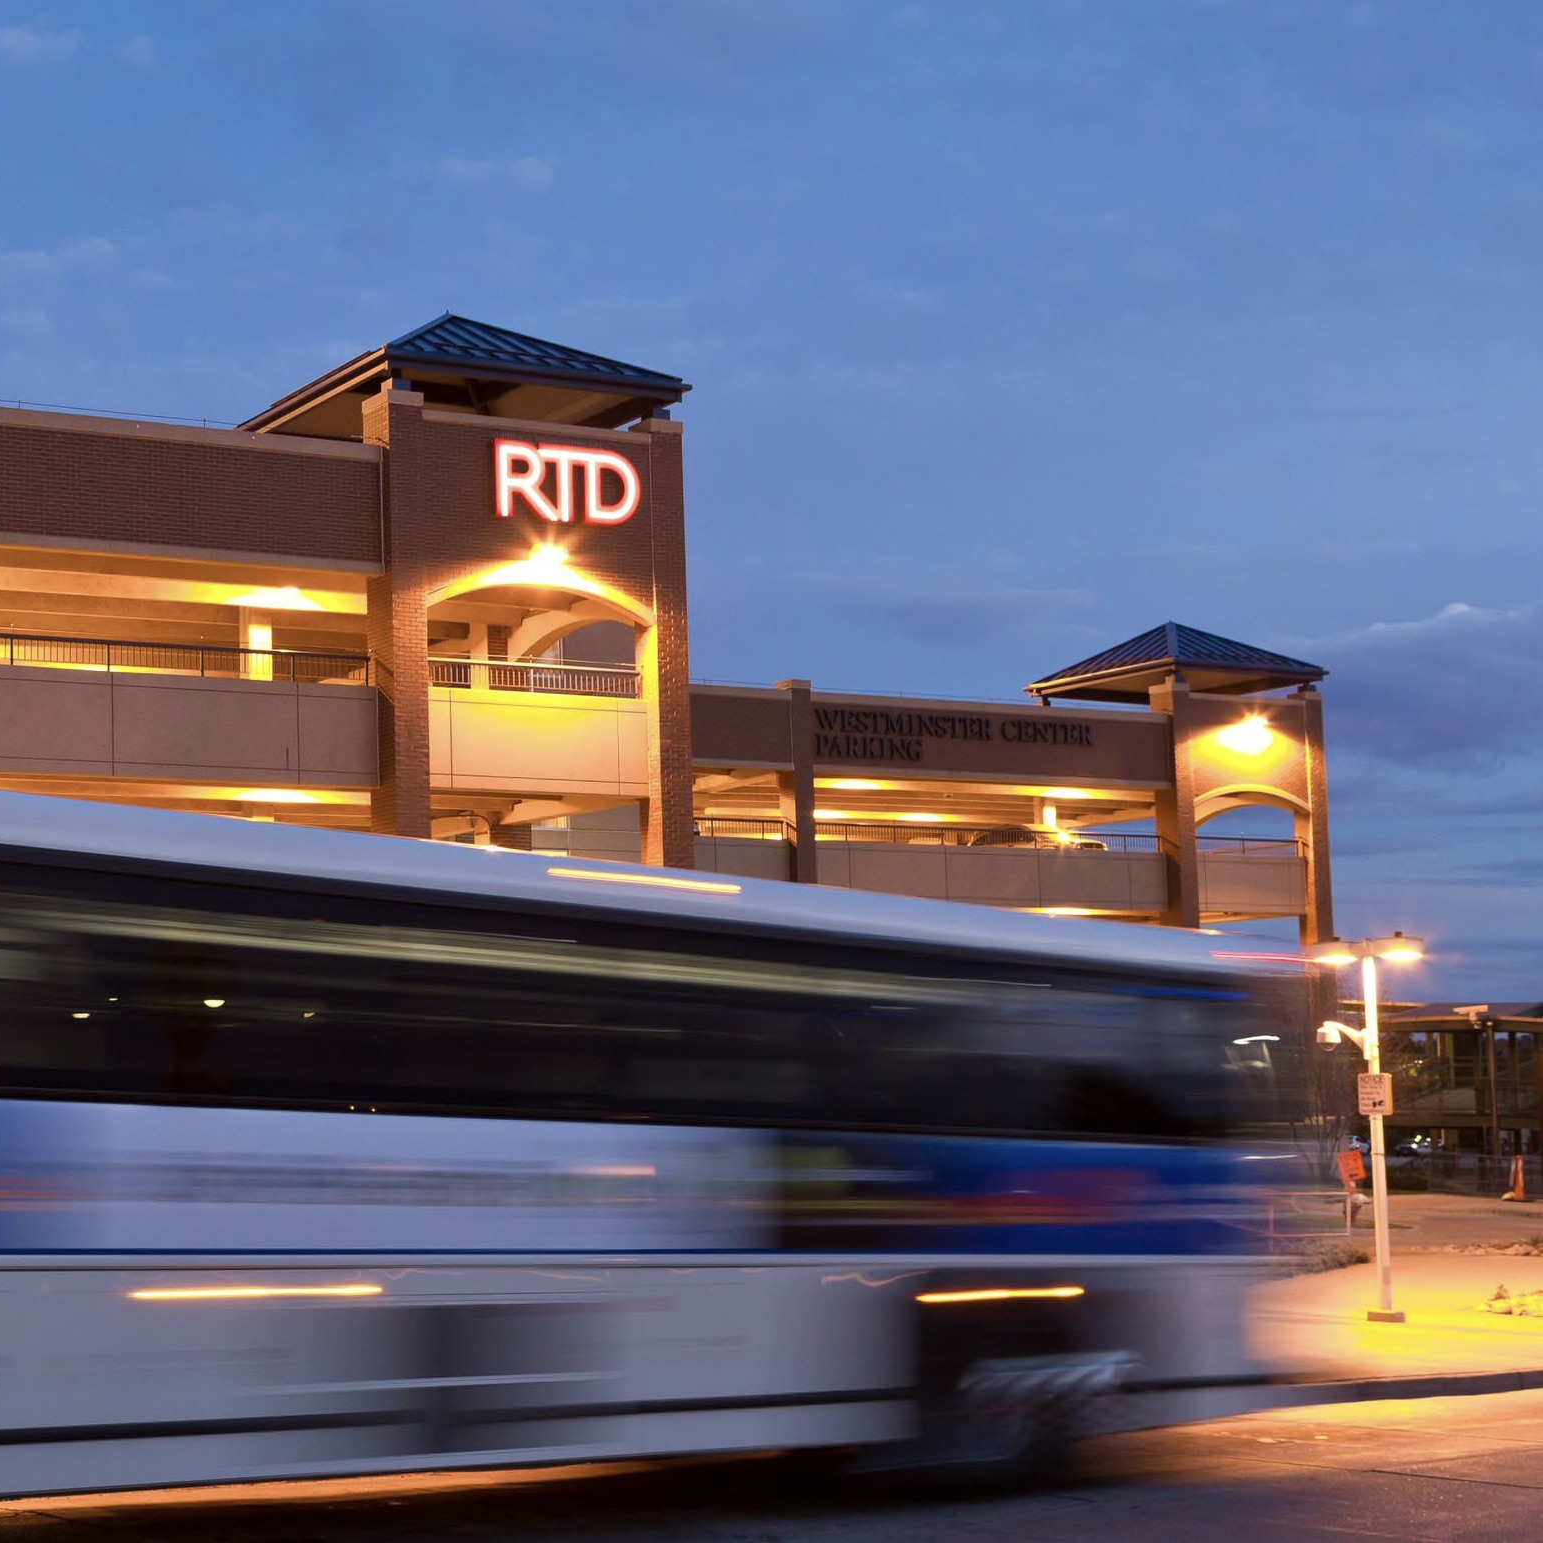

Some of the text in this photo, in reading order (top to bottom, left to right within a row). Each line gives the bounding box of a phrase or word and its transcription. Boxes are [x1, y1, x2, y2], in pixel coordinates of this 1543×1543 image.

[494, 438, 642, 526] RTD
[814, 708, 1094, 747] WESTMINSTER CENTER
[814, 734, 924, 762] PARKING
